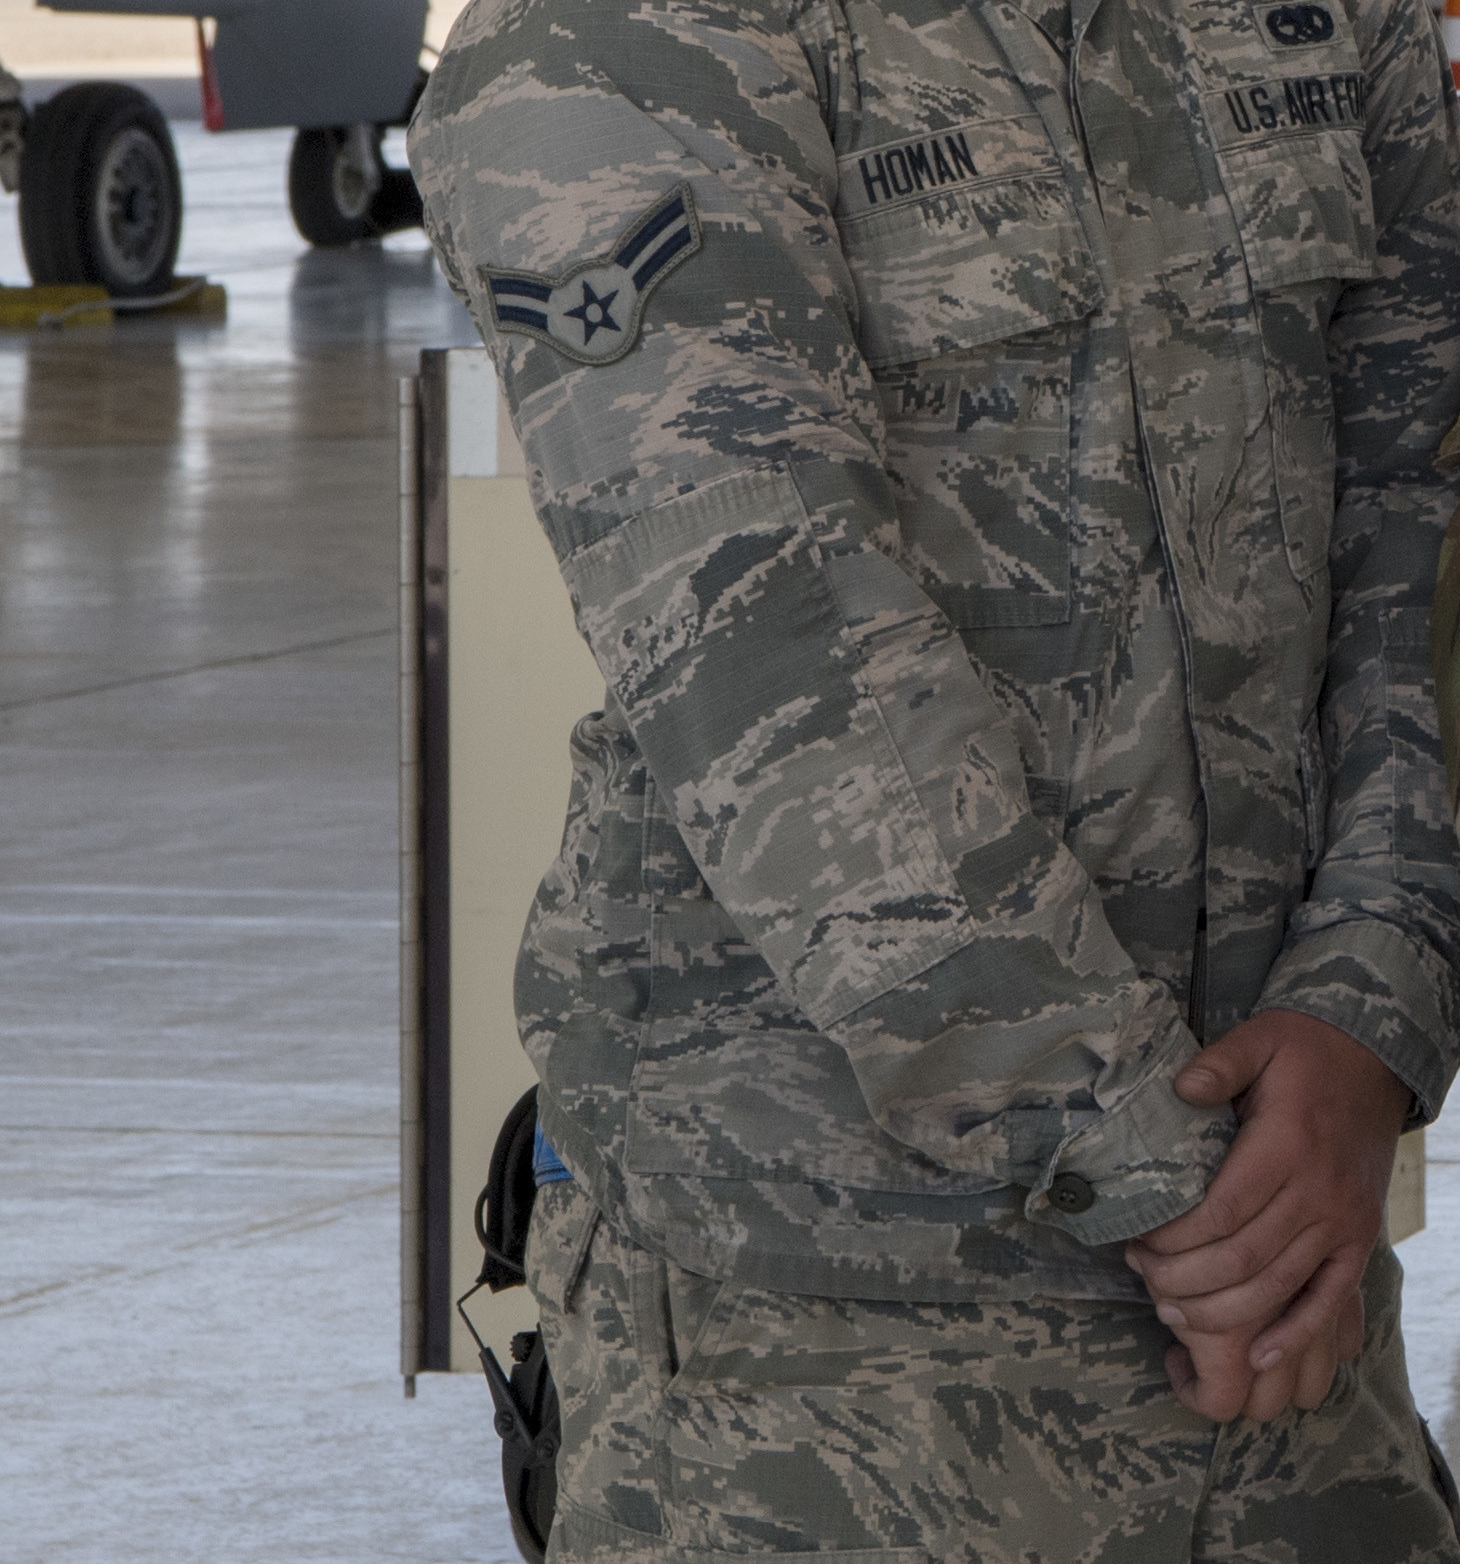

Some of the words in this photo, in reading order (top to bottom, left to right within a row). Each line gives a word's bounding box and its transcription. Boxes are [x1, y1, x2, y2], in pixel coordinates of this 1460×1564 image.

[1224, 86, 1287, 134] U.S.
[1282, 76, 1331, 126] AIR
[858, 132, 979, 204] HOMAN
